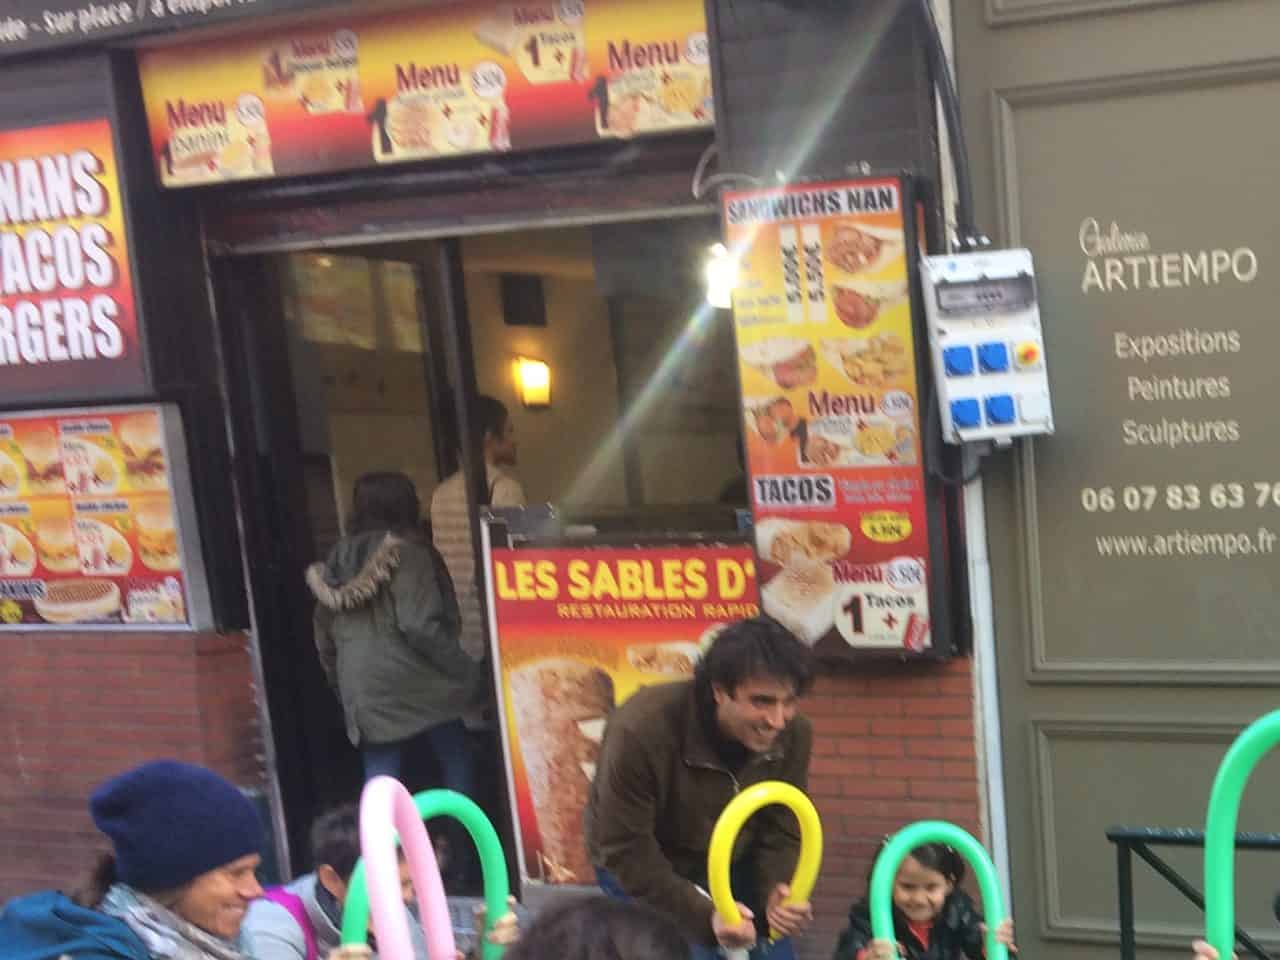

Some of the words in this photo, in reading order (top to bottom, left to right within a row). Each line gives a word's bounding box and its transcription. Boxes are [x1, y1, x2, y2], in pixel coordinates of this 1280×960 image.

[43, 9, 76, 35] Sur
[78, 3, 134, 33] place
[607, 38, 679, 71] Menu
[395, 62, 461, 92] Menu
[166, 97, 227, 129] Menu
[847, 187, 894, 212] NAN
[0, 224, 114, 295] ACOS
[1081, 247, 1258, 293] ARTIEMPO
[1114, 329, 1241, 361] Expositions
[808, 391, 876, 416] Menu
[1127, 375, 1232, 401] Peintures
[1122, 418, 1241, 447] Sculptures
[757, 477, 833, 502] TACOS
[1080, 487, 1116, 512] 06
[1122, 486, 1158, 511] 07
[1165, 485, 1201, 510] 83
[1209, 483, 1246, 508] 63
[1095, 527, 1278, 559] www.artiempo.fr
[495, 560, 559, 600] LES
[567, 560, 708, 600] SABLES
[832, 562, 883, 584] Menu
[557, 602, 697, 620] RESTAURATION
[842, 592, 864, 634] 1
[864, 593, 916, 608] Tacos
